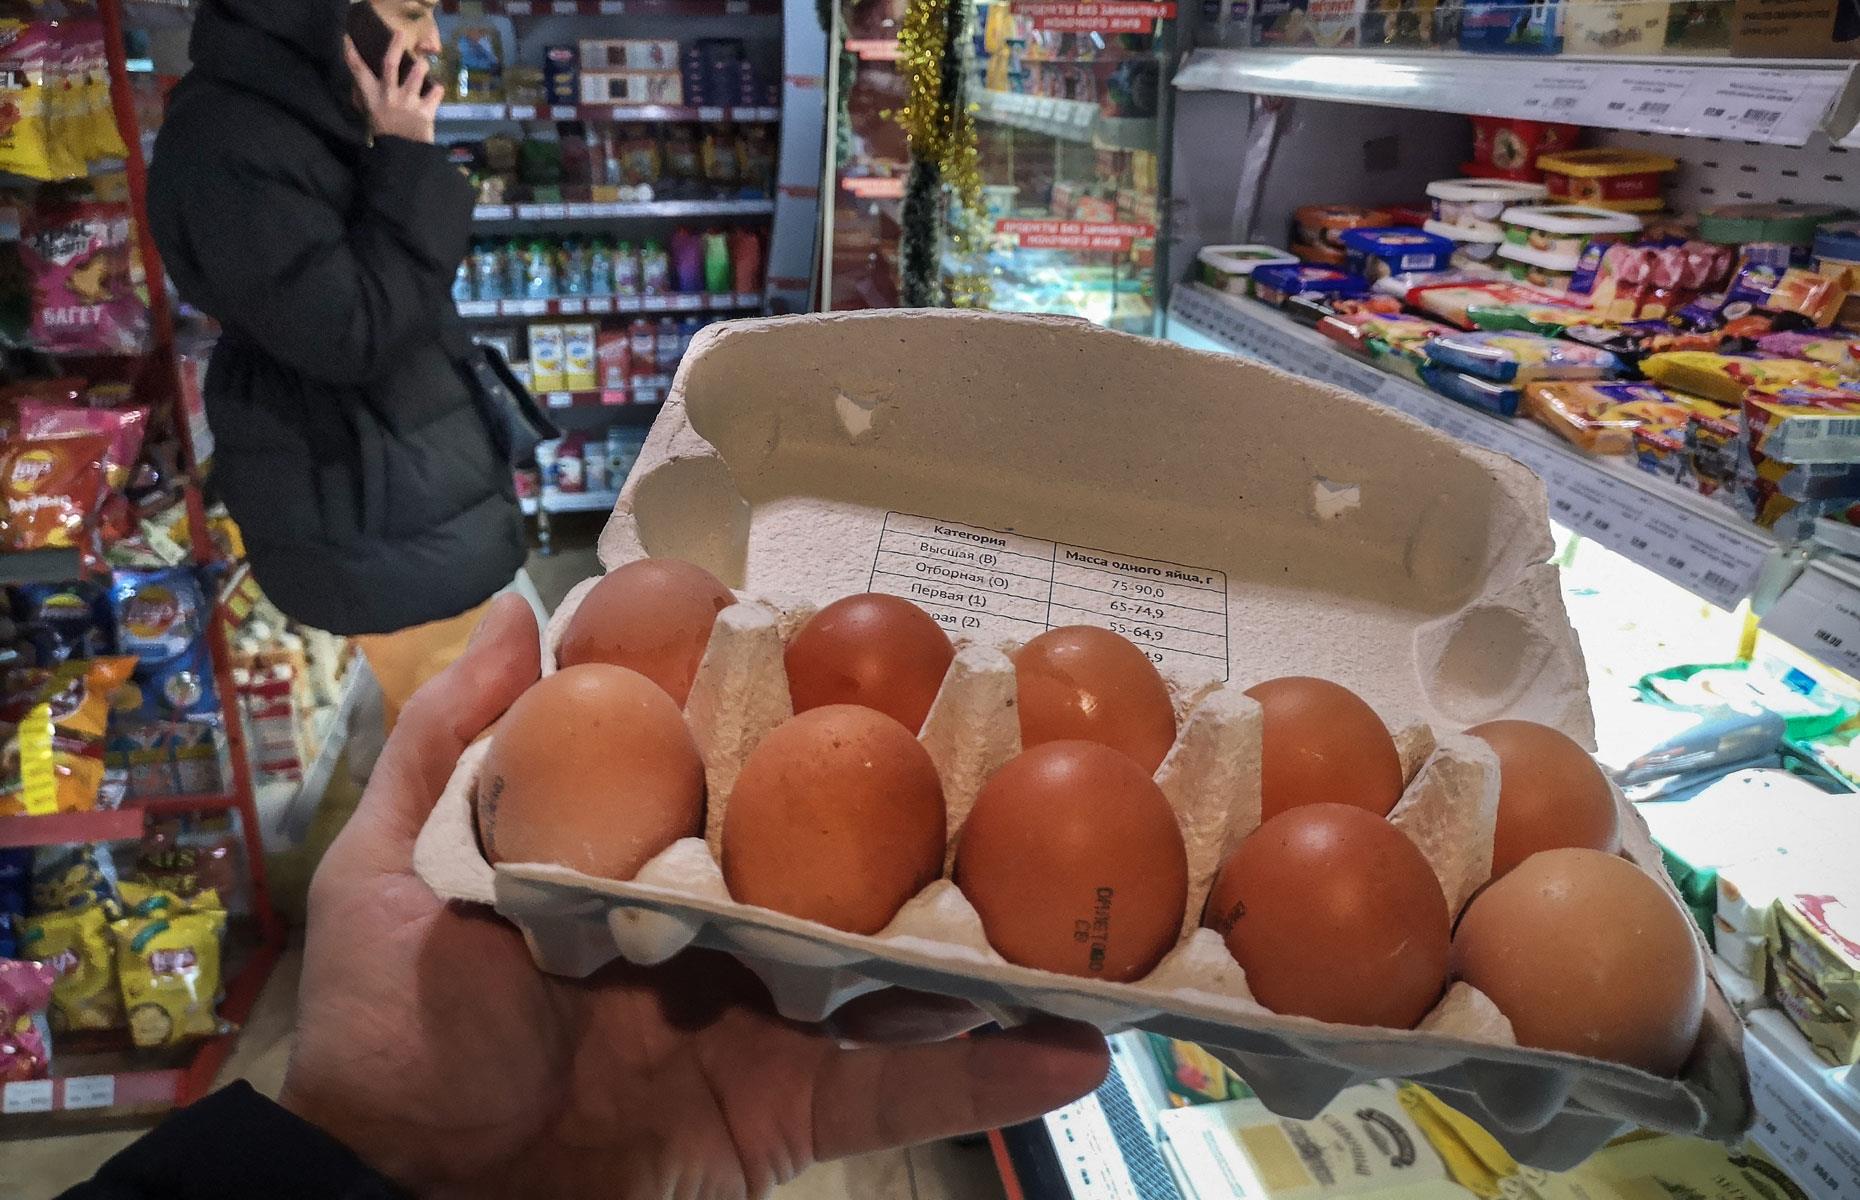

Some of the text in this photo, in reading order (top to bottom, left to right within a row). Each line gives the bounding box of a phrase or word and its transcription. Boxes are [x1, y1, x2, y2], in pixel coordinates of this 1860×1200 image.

[934, 525, 1007, 547] Категория
[920, 542, 997, 566] Высшая (В)
[915, 562, 1009, 590] Отборная (О)
[1065, 550, 1213, 585] Масса одного яйца, г
[911, 583, 987, 608] Первая (1)
[1111, 579, 1165, 598] 75-90,0
[1110, 600, 1164, 619] 65-74,9
[961, 615, 980, 629] (2)
[1109, 622, 1163, 641] 55-64,9
